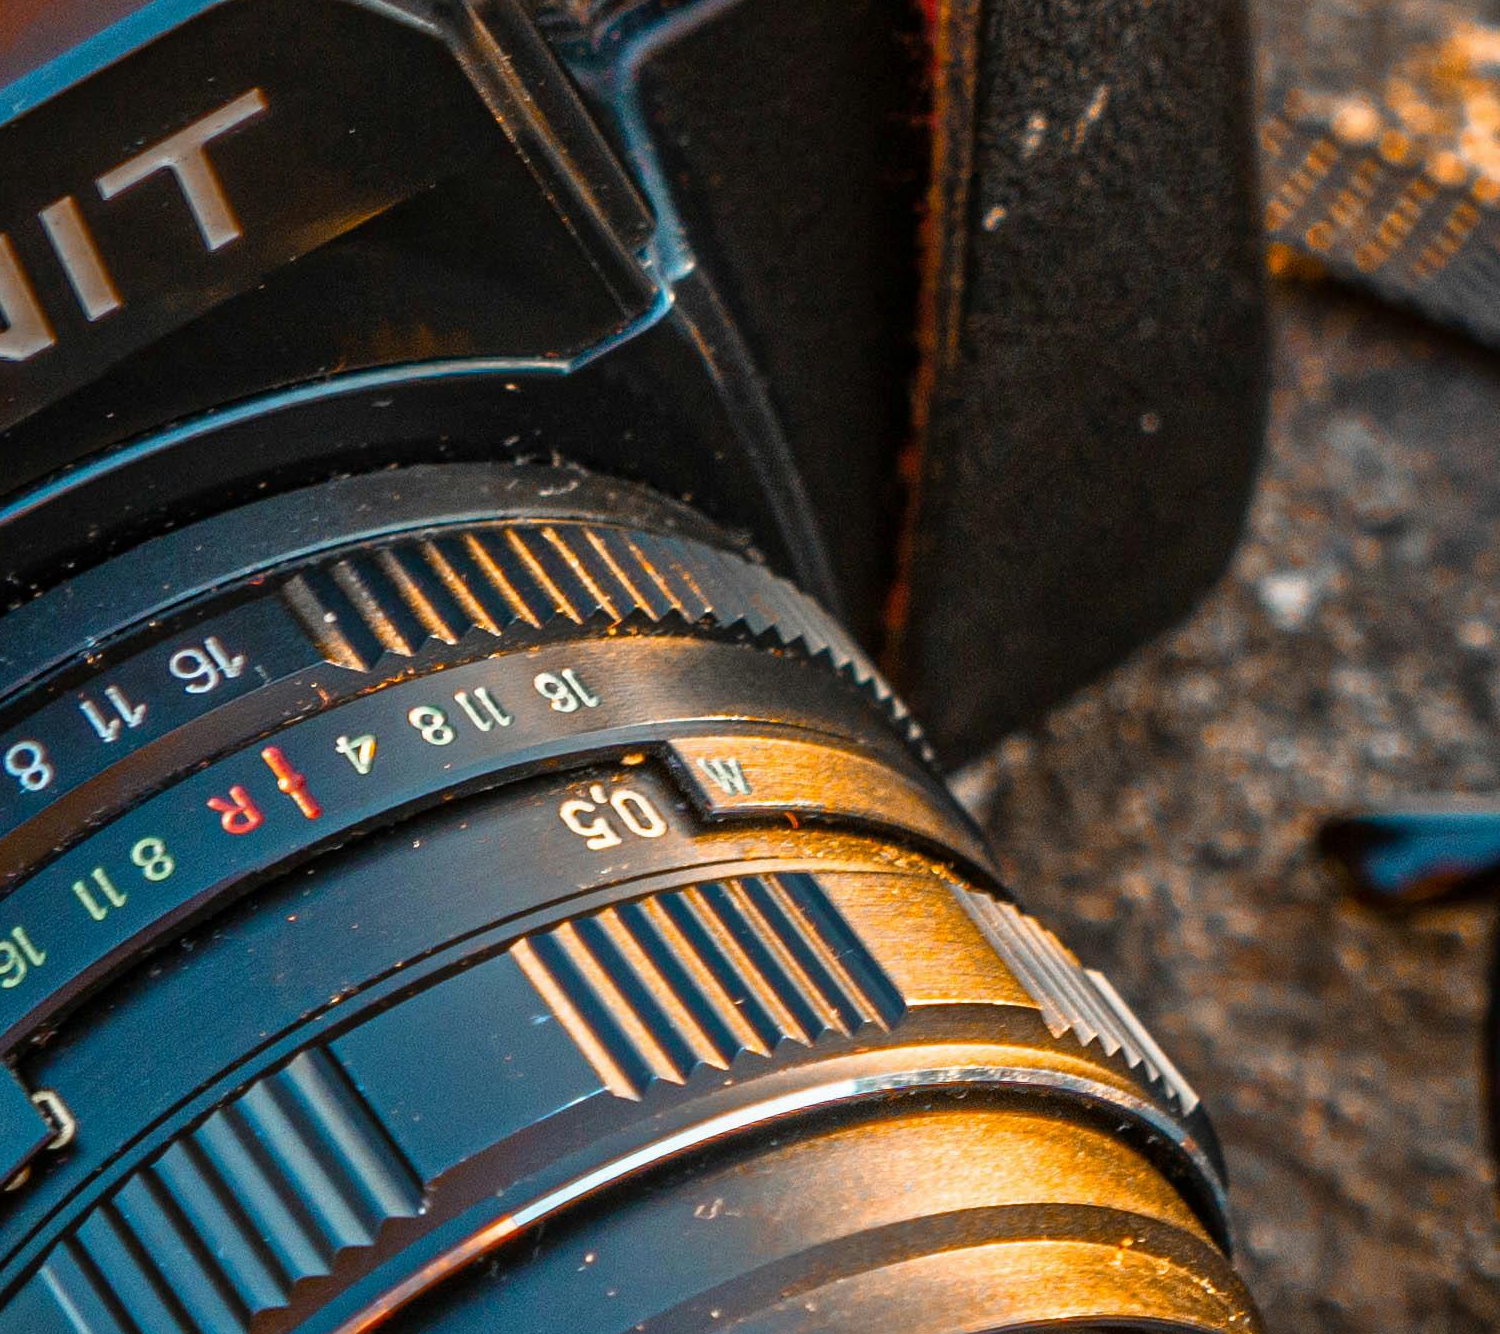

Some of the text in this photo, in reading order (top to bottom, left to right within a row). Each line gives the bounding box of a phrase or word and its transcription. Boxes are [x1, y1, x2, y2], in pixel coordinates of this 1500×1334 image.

[169, 636, 246, 695] 16
[79, 685, 147, 743] 11
[335, 668, 600, 775] 16 11 8 4
[3, 739, 55, 792] 8
[206, 785, 265, 835] R
[558, 784, 668, 851] 0,5
[131, 837, 175, 882] 8
[71, 867, 127, 922] 11
